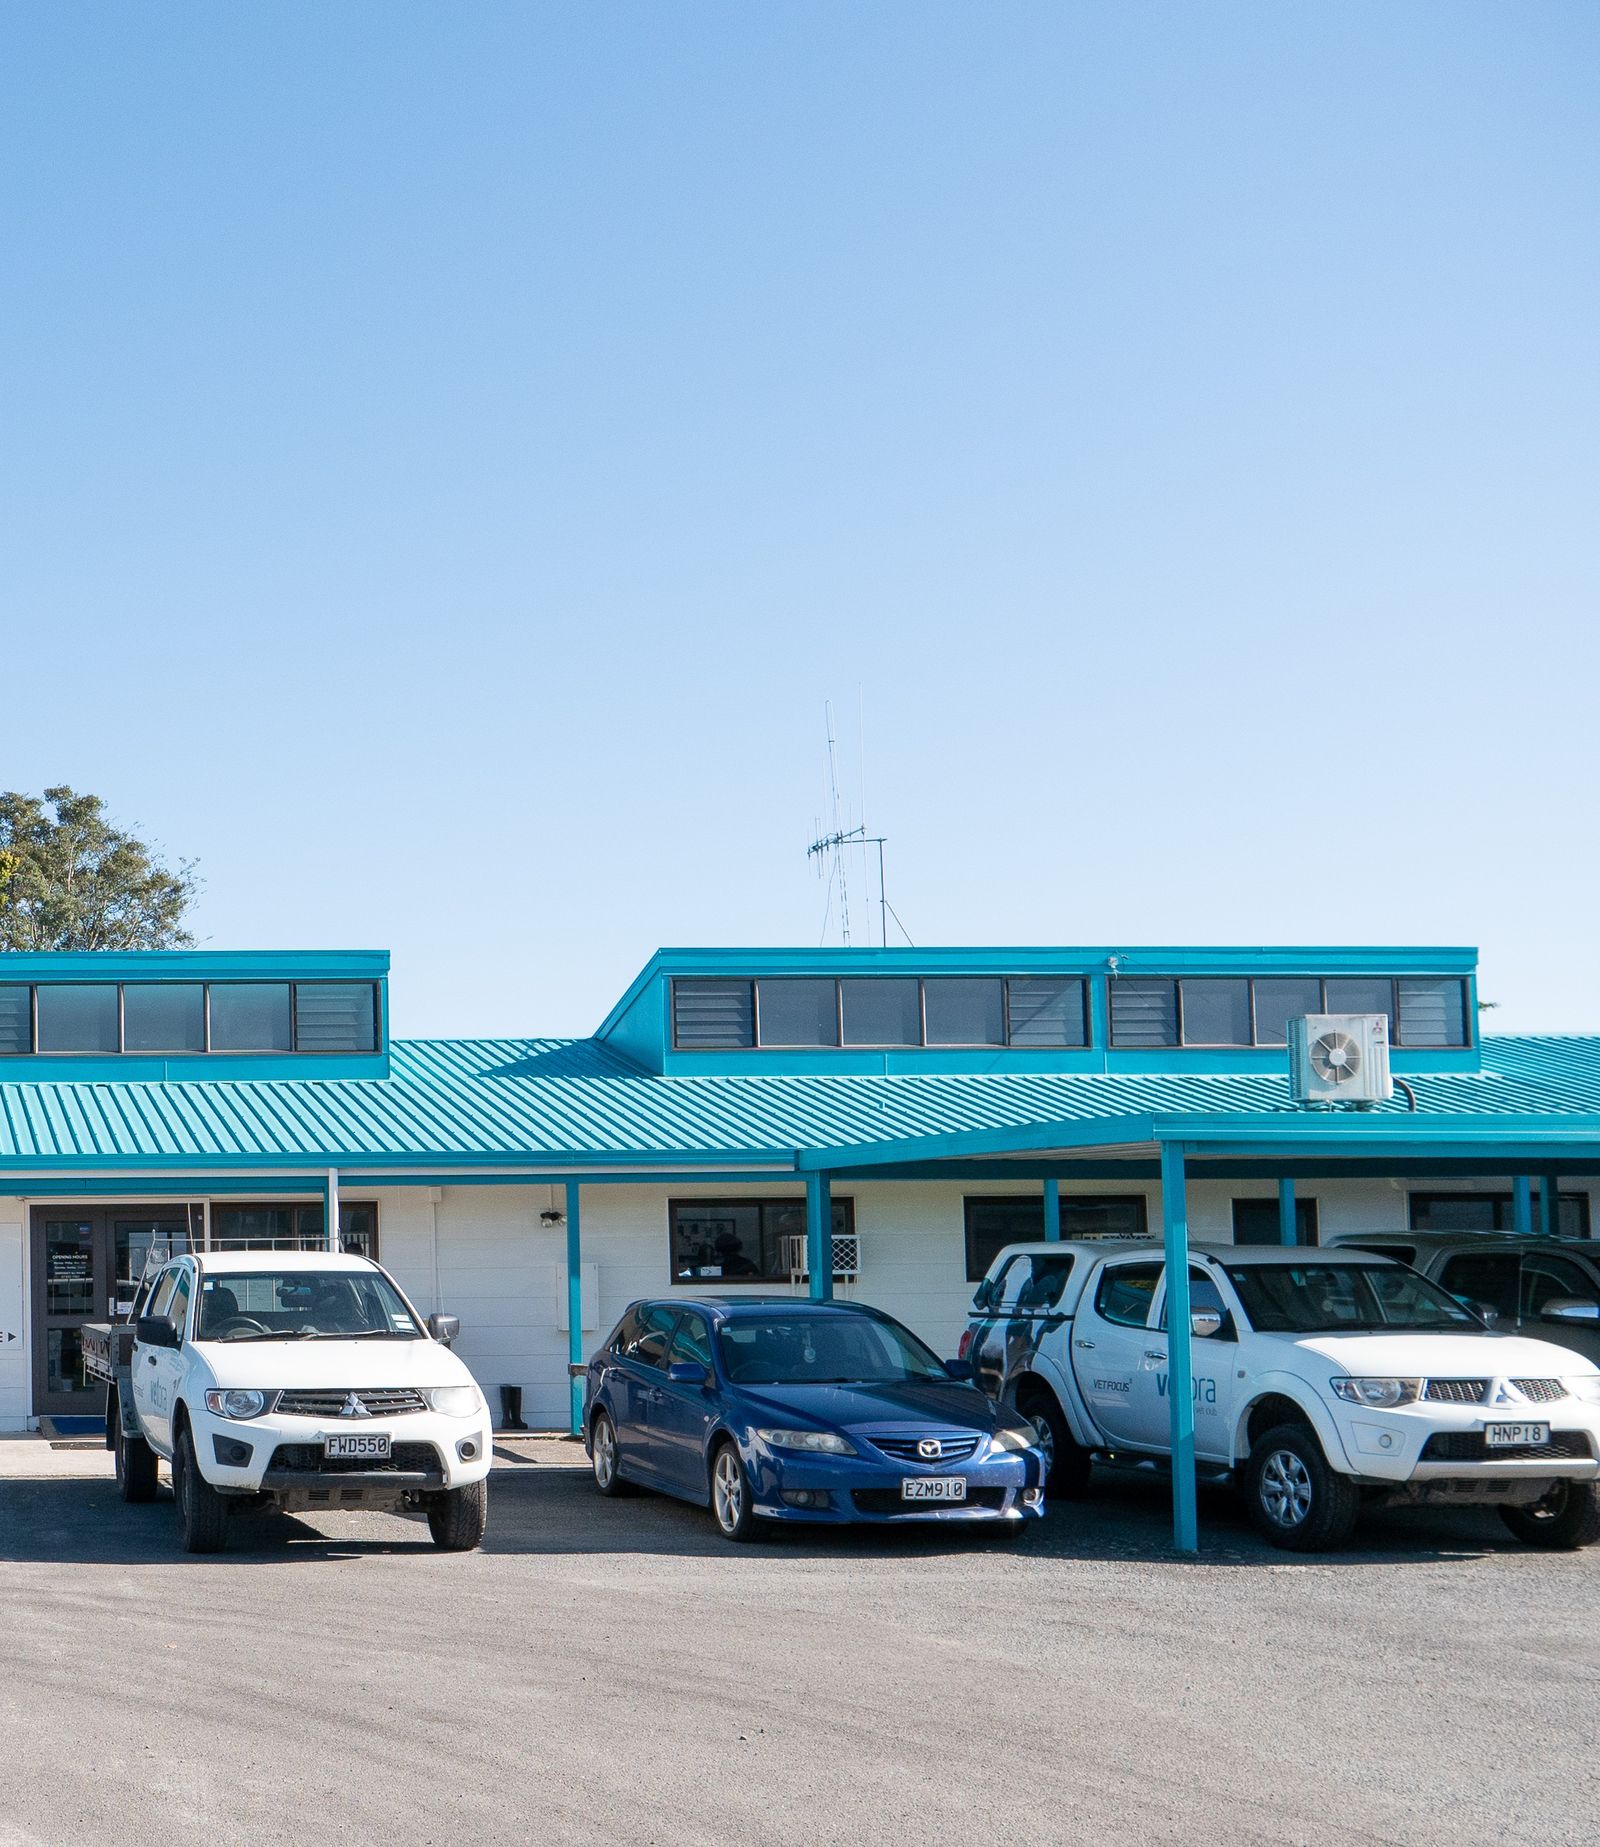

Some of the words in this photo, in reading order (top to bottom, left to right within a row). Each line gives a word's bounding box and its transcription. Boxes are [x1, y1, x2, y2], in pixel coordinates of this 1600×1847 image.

[1492, 1426, 1541, 1442] HNP18
[328, 1438, 387, 1453] FWD550
[905, 1482, 963, 1497] EZM910
